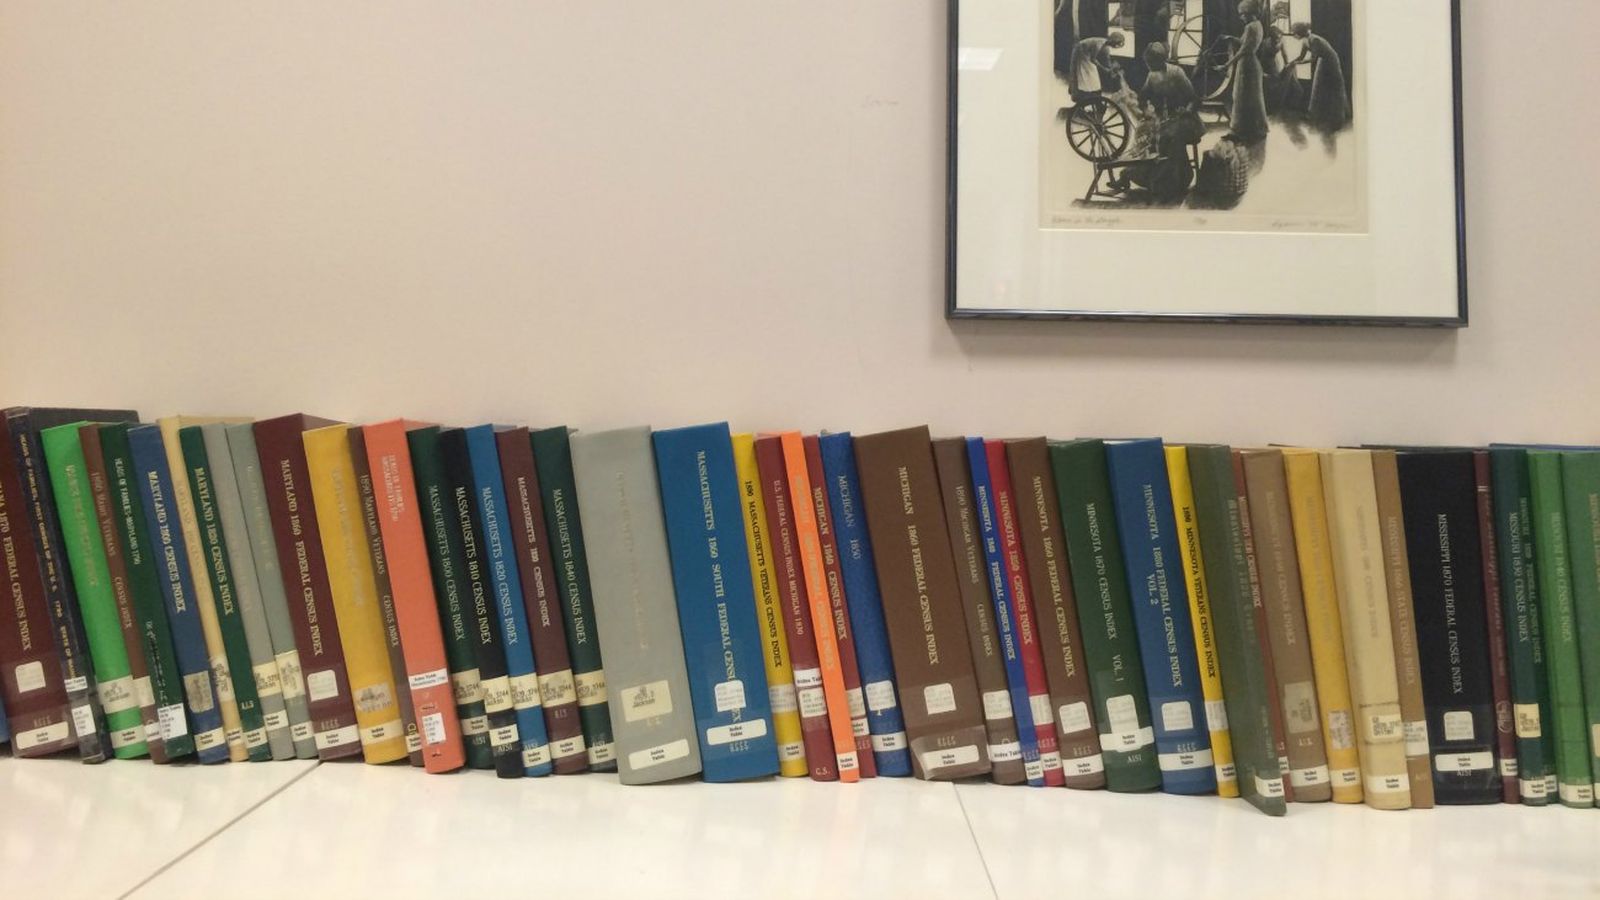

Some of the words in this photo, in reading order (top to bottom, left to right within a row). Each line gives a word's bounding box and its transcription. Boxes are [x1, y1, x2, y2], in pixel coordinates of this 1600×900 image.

[279, 459, 297, 512] MARYLAND
[695, 450, 714, 530] MASSACHUSETTS
[837, 474, 855, 527] MICHIGAN
[897, 466, 913, 514] MICHIGAN
[1031, 475, 1049, 531] MINNESOTA
[427, 484, 449, 555] MASSACHUSETTS
[454, 486, 476, 558] MASSACHUSETTS
[482, 486, 502, 558] MASSACHUSETTS
[552, 487, 572, 558] MASSACHUSETTS
[775, 494, 786, 525] FEDERAL
[1085, 502, 1101, 552] MINNESOTA
[1141, 483, 1159, 540] MINNESOTA
[147, 470, 166, 523] MARYLAND
[163, 545, 179, 582] CENSUS
[171, 582, 186, 613] INDEX
[194, 467, 213, 521] MARYLAND
[211, 545, 226, 582] CENSUS
[219, 583, 233, 614] INDEX
[359, 474, 370, 494] 1890
[382, 594, 395, 623] CENSUS
[780, 527, 791, 555] CENSUS
[1437, 513, 1449, 562] MISSISSIPPI
[1508, 511, 1519, 553] MISSOURI
[24, 457, 31, 467] OF
[64, 647, 71, 657] OF
[294, 540, 310, 586] FEDERAL
[441, 556, 453, 577] 1800
[785, 556, 795, 577] INDEX
[813, 486, 829, 535] MICHIGAN
[827, 570, 841, 607] CENSUS
[834, 609, 847, 639] INDEX
[998, 491, 1015, 546] MINNESOTA
[1013, 574, 1027, 612] CENSUS
[1020, 613, 1032, 644] INDEX
[1094, 554, 1105, 575] 1870
[1185, 526, 1199, 575] MINNESOTA
[1512, 556, 1521, 576] 1830
[468, 560, 480, 580] 1810
[495, 559, 506, 580] 1820
[532, 566, 544, 597] CENSUS
[564, 560, 576, 581] 1840
[711, 563, 723, 597] SOUTH
[748, 500, 765, 566] MASSACHUSETTS
[760, 568, 771, 605] VETERANS
[766, 606, 777, 638] CENSUS
[772, 640, 782, 667] INDEX
[911, 547, 926, 593] FEDERAL
[977, 485, 992, 531] MINNESOTA
[991, 561, 1004, 599] FEDERAL
[998, 600, 1010, 632] CENSUS
[1004, 633, 1015, 660] INDEX
[1046, 559, 1062, 605] FEDERAL
[1442, 565, 1451, 585] 1870
[2, 536, 18, 581] FEDERAL
[11, 582, 25, 618] CENSUS
[18, 620, 31, 650] INDEX
[302, 586, 317, 623] CENSUS
[445, 578, 459, 611] CENSUS
[472, 581, 486, 614] CENSUS
[498, 582, 512, 615] CENSUS
[568, 581, 582, 615] CENSUS
[789, 580, 801, 615] MICHIGAN
[1098, 576, 1111, 610] CENSUS
[1155, 568, 1171, 614] FEDERAL
[1193, 577, 1205, 614] VETERANS
[1444, 588, 1455, 627] FEDERAL
[1514, 578, 1525, 612] CENSUS
[1557, 578, 1568, 612] CENSUS
[451, 613, 464, 640] INDEX
[574, 616, 587, 644] INDEX
[716, 603, 730, 648] FEDERAL
[919, 594, 933, 631] CENSUS
[976, 602, 989, 632] CENSUS
[1054, 606, 1069, 644] CENSUS
[1104, 612, 1117, 640] INDEX
[1518, 615, 1528, 641] INDEX
[309, 624, 323, 655] INDEX
[478, 616, 492, 645] INDEX
[505, 617, 517, 644] INDEX
[1163, 616, 1177, 653] CENSUS
[1200, 616, 1211, 647] CENSUS
[1448, 630, 1458, 664] CENSUS
[925, 633, 938, 665] INDEX
[1061, 645, 1075, 677] INDEX
[1205, 650, 1215, 678] INDEX
[1169, 654, 1183, 687] INDEX
[1451, 666, 1461, 693] INDEX
